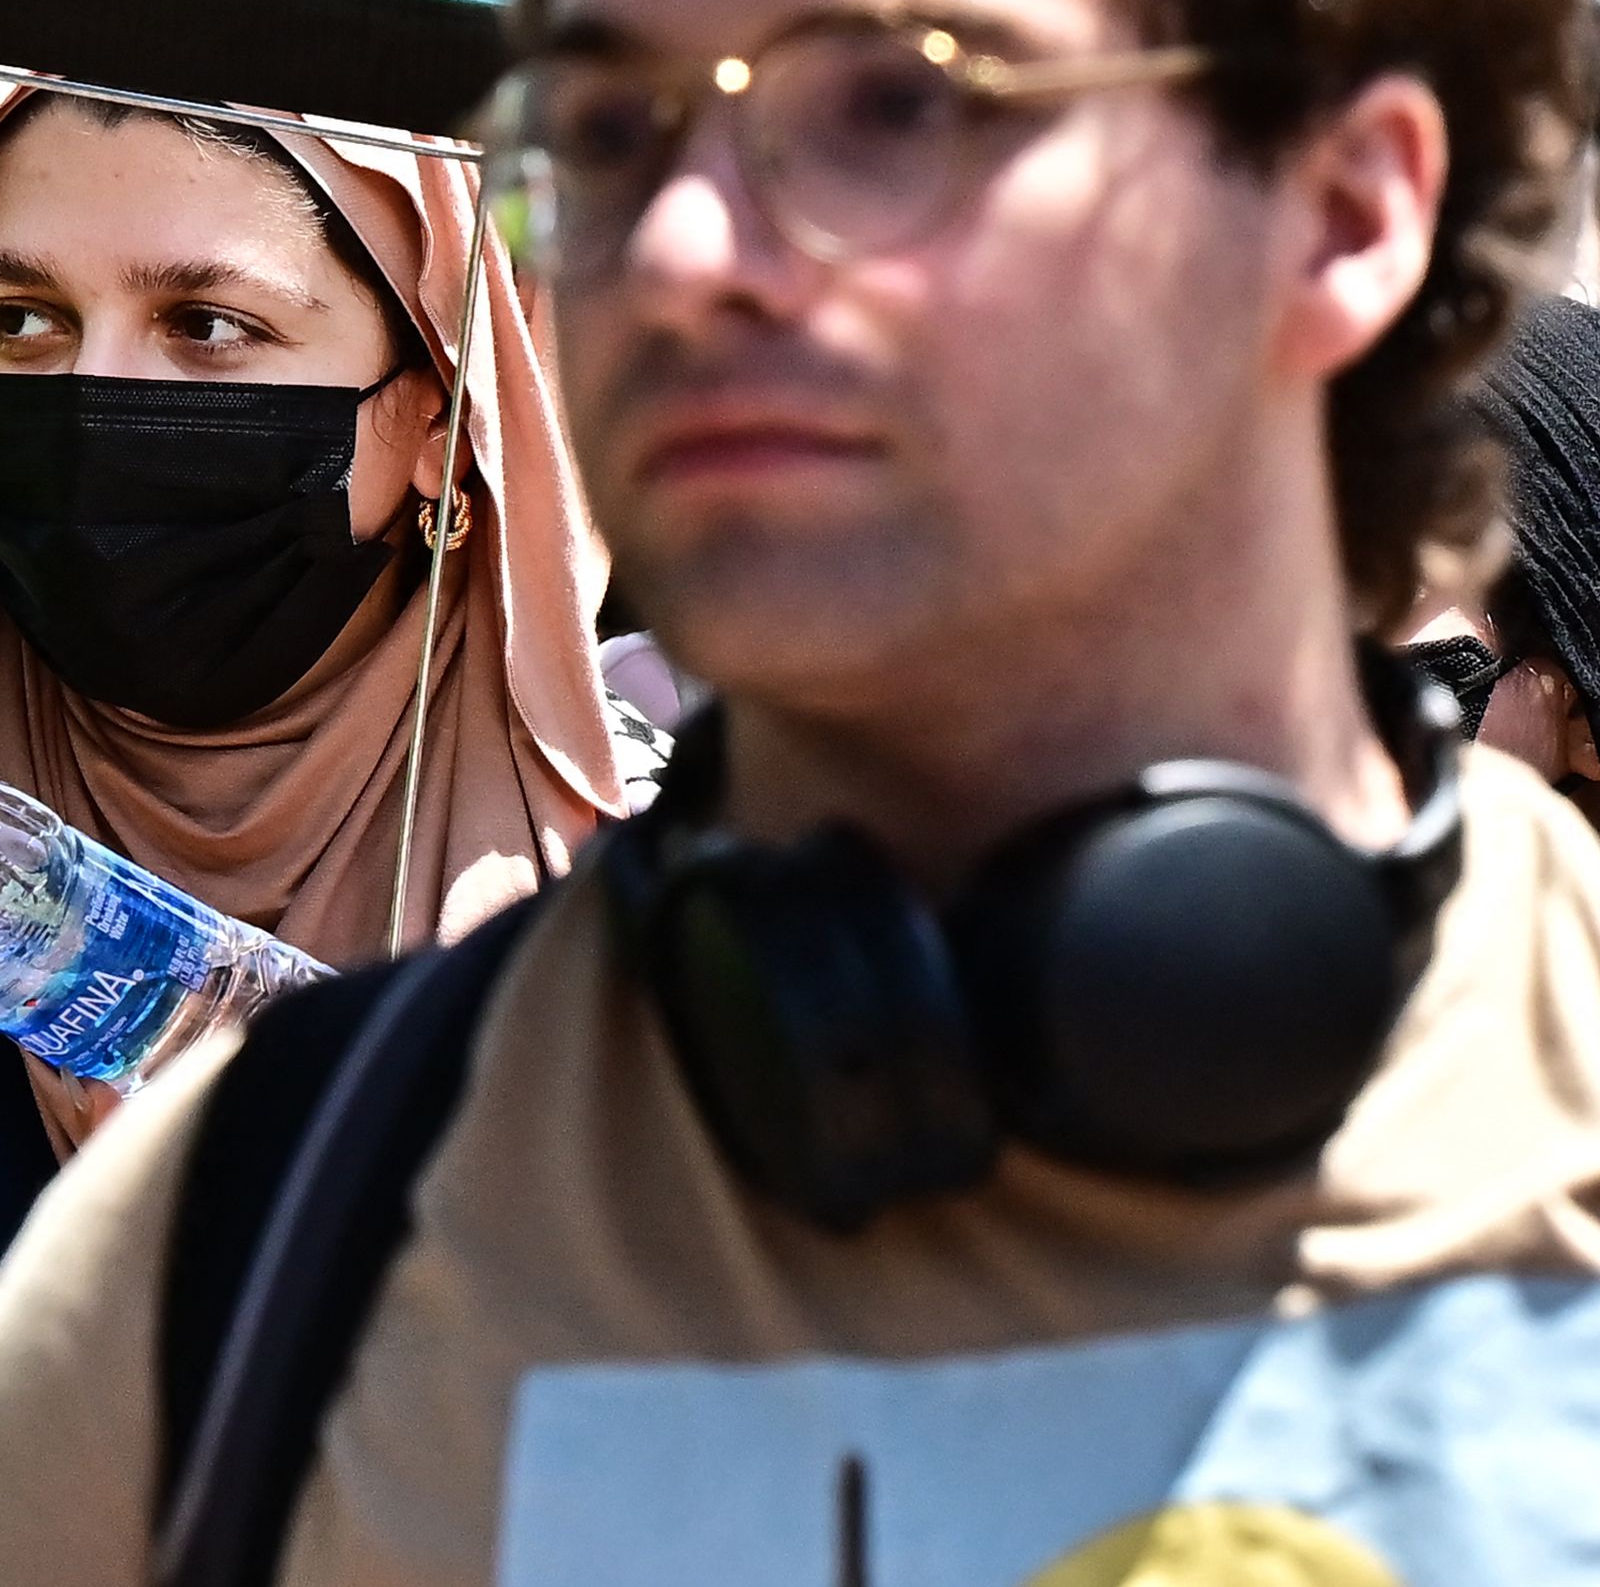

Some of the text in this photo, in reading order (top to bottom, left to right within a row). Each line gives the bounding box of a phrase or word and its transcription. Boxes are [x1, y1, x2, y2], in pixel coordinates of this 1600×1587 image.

[98, 893, 122, 934] Drinking
[109, 910, 130, 941] Water
[18, 970, 137, 1057] QUAFINA
